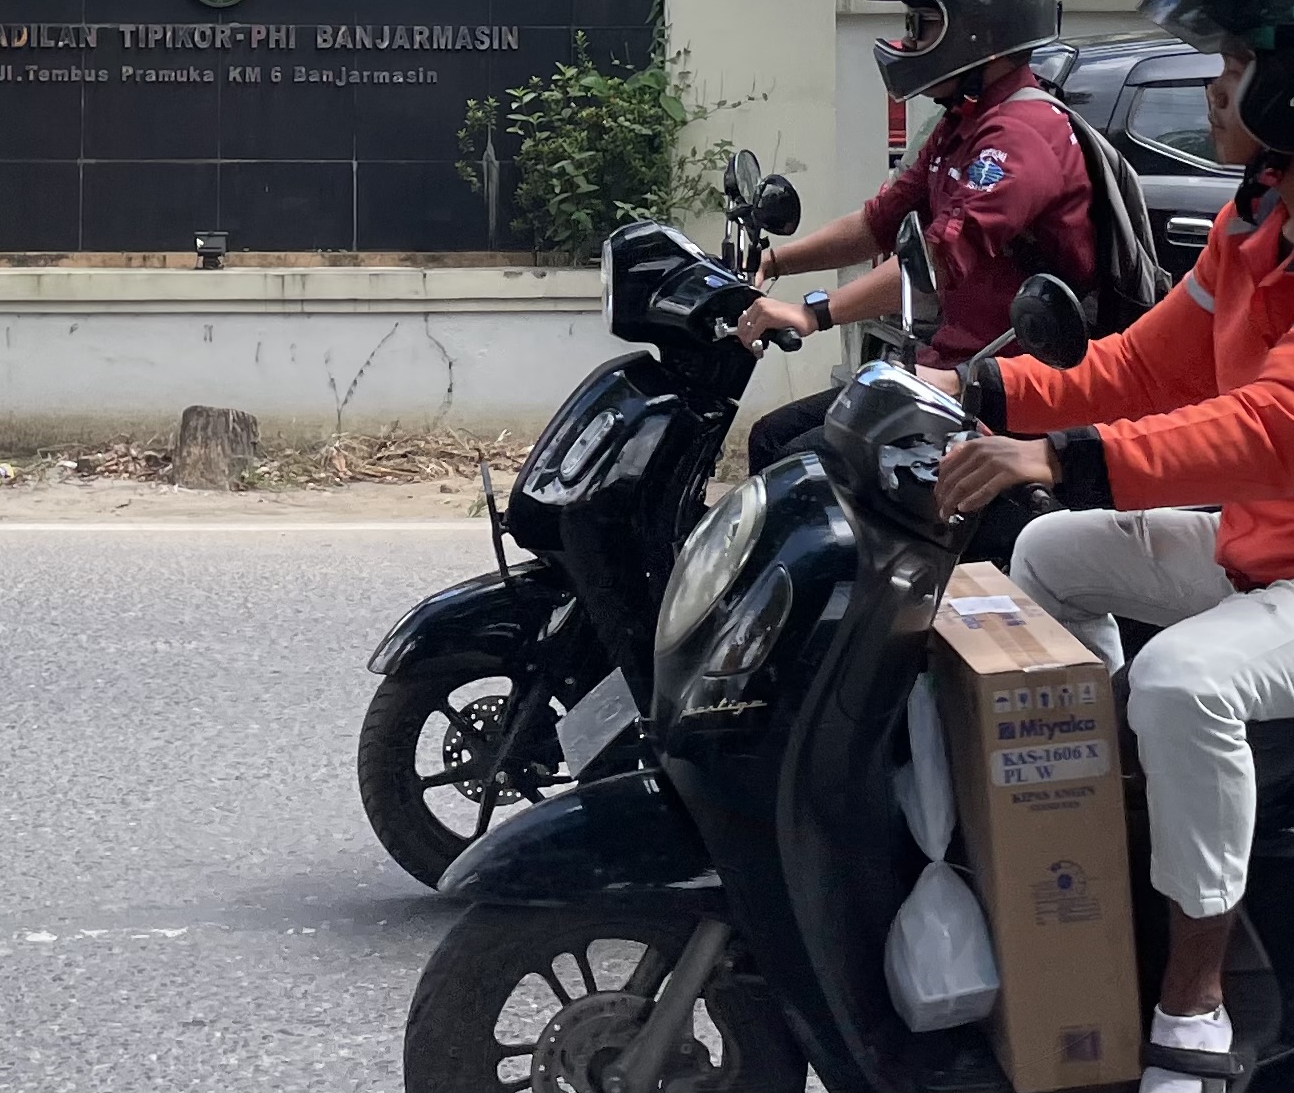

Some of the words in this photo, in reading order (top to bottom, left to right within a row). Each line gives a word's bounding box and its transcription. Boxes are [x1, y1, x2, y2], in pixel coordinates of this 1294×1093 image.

[119, 24, 296, 50] TIPIKOR-PHI
[316, 25, 520, 50] BANJARMASIN
[121, 65, 215, 83] Pramuka
[228, 66, 262, 83] KM
[270, 66, 282, 83] 6
[293, 66, 439, 87] Banjarmasin
[1019, 713, 1096, 740] Miyako
[1002, 745, 1082, 767] KAS-1606
[1085, 744, 1099, 759] X
[1003, 768, 1027, 784] PL
[1035, 764, 1054, 780] W
